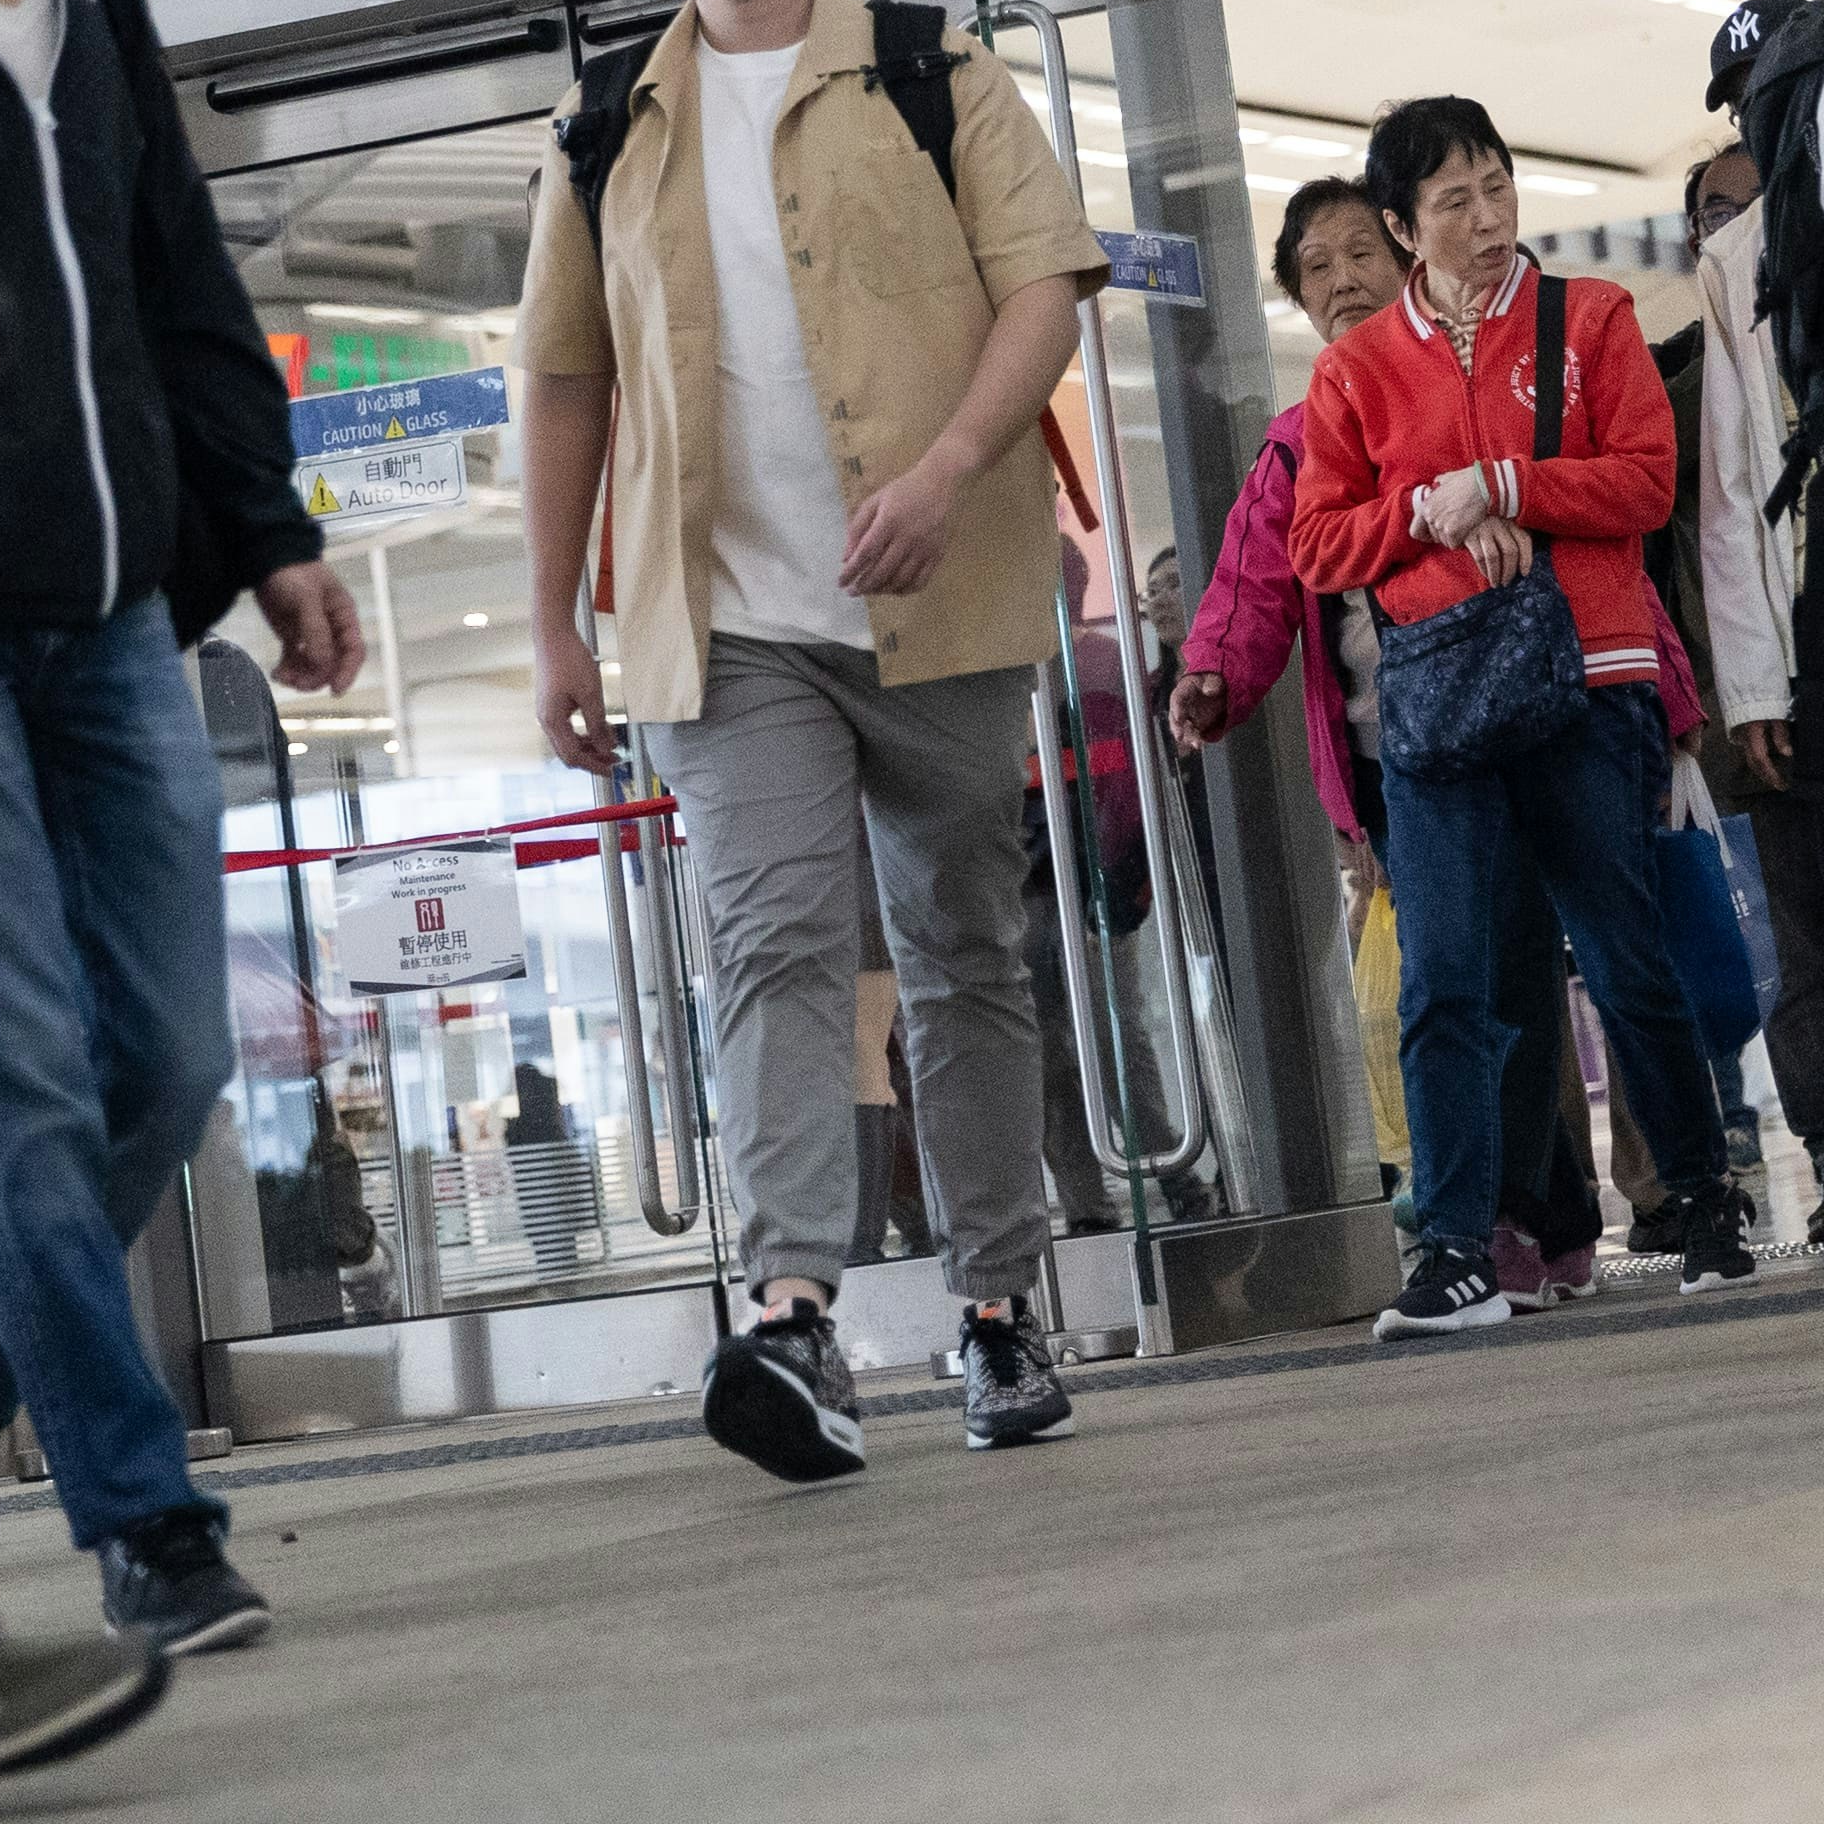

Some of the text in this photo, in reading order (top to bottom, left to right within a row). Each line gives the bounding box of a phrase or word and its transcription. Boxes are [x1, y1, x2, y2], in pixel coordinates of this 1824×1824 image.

[357, 388, 422, 417] 小心玻璃
[323, 411, 449, 446] CAUTION GLASS
[365, 453, 423, 483] 自動門
[348, 477, 448, 509] Auto Door
[393, 859, 412, 873] No
[399, 871, 456, 886] Maintenance
[391, 883, 467, 899] Work in progress
[398, 930, 468, 956] 暫停使用
